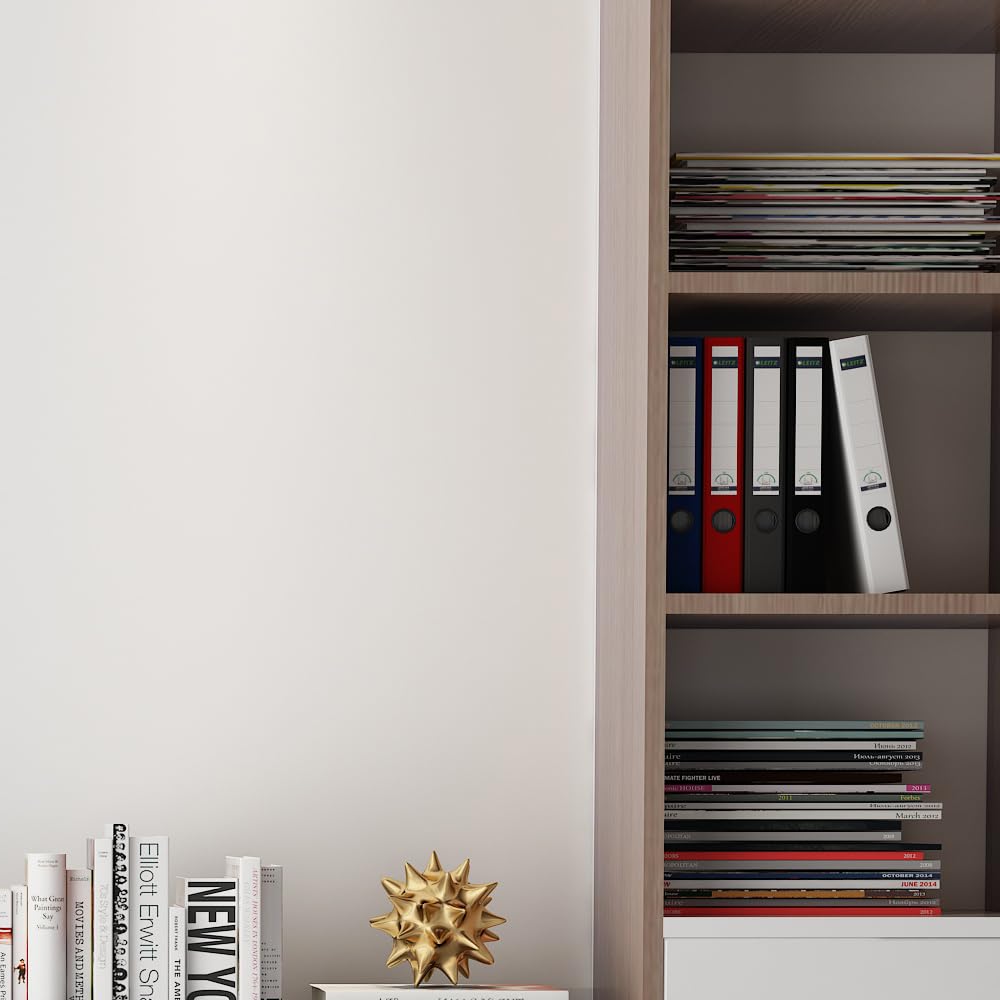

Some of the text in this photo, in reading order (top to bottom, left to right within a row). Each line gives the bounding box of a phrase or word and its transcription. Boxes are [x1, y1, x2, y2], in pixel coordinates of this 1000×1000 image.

[140, 843, 158, 896] Elliott
[75, 901, 84, 945] MOVIES
[140, 905, 158, 960] Erwitt
[188, 882, 236, 956] NEW
[0, 952, 6, 961] An
[75, 947, 84, 970] AND
